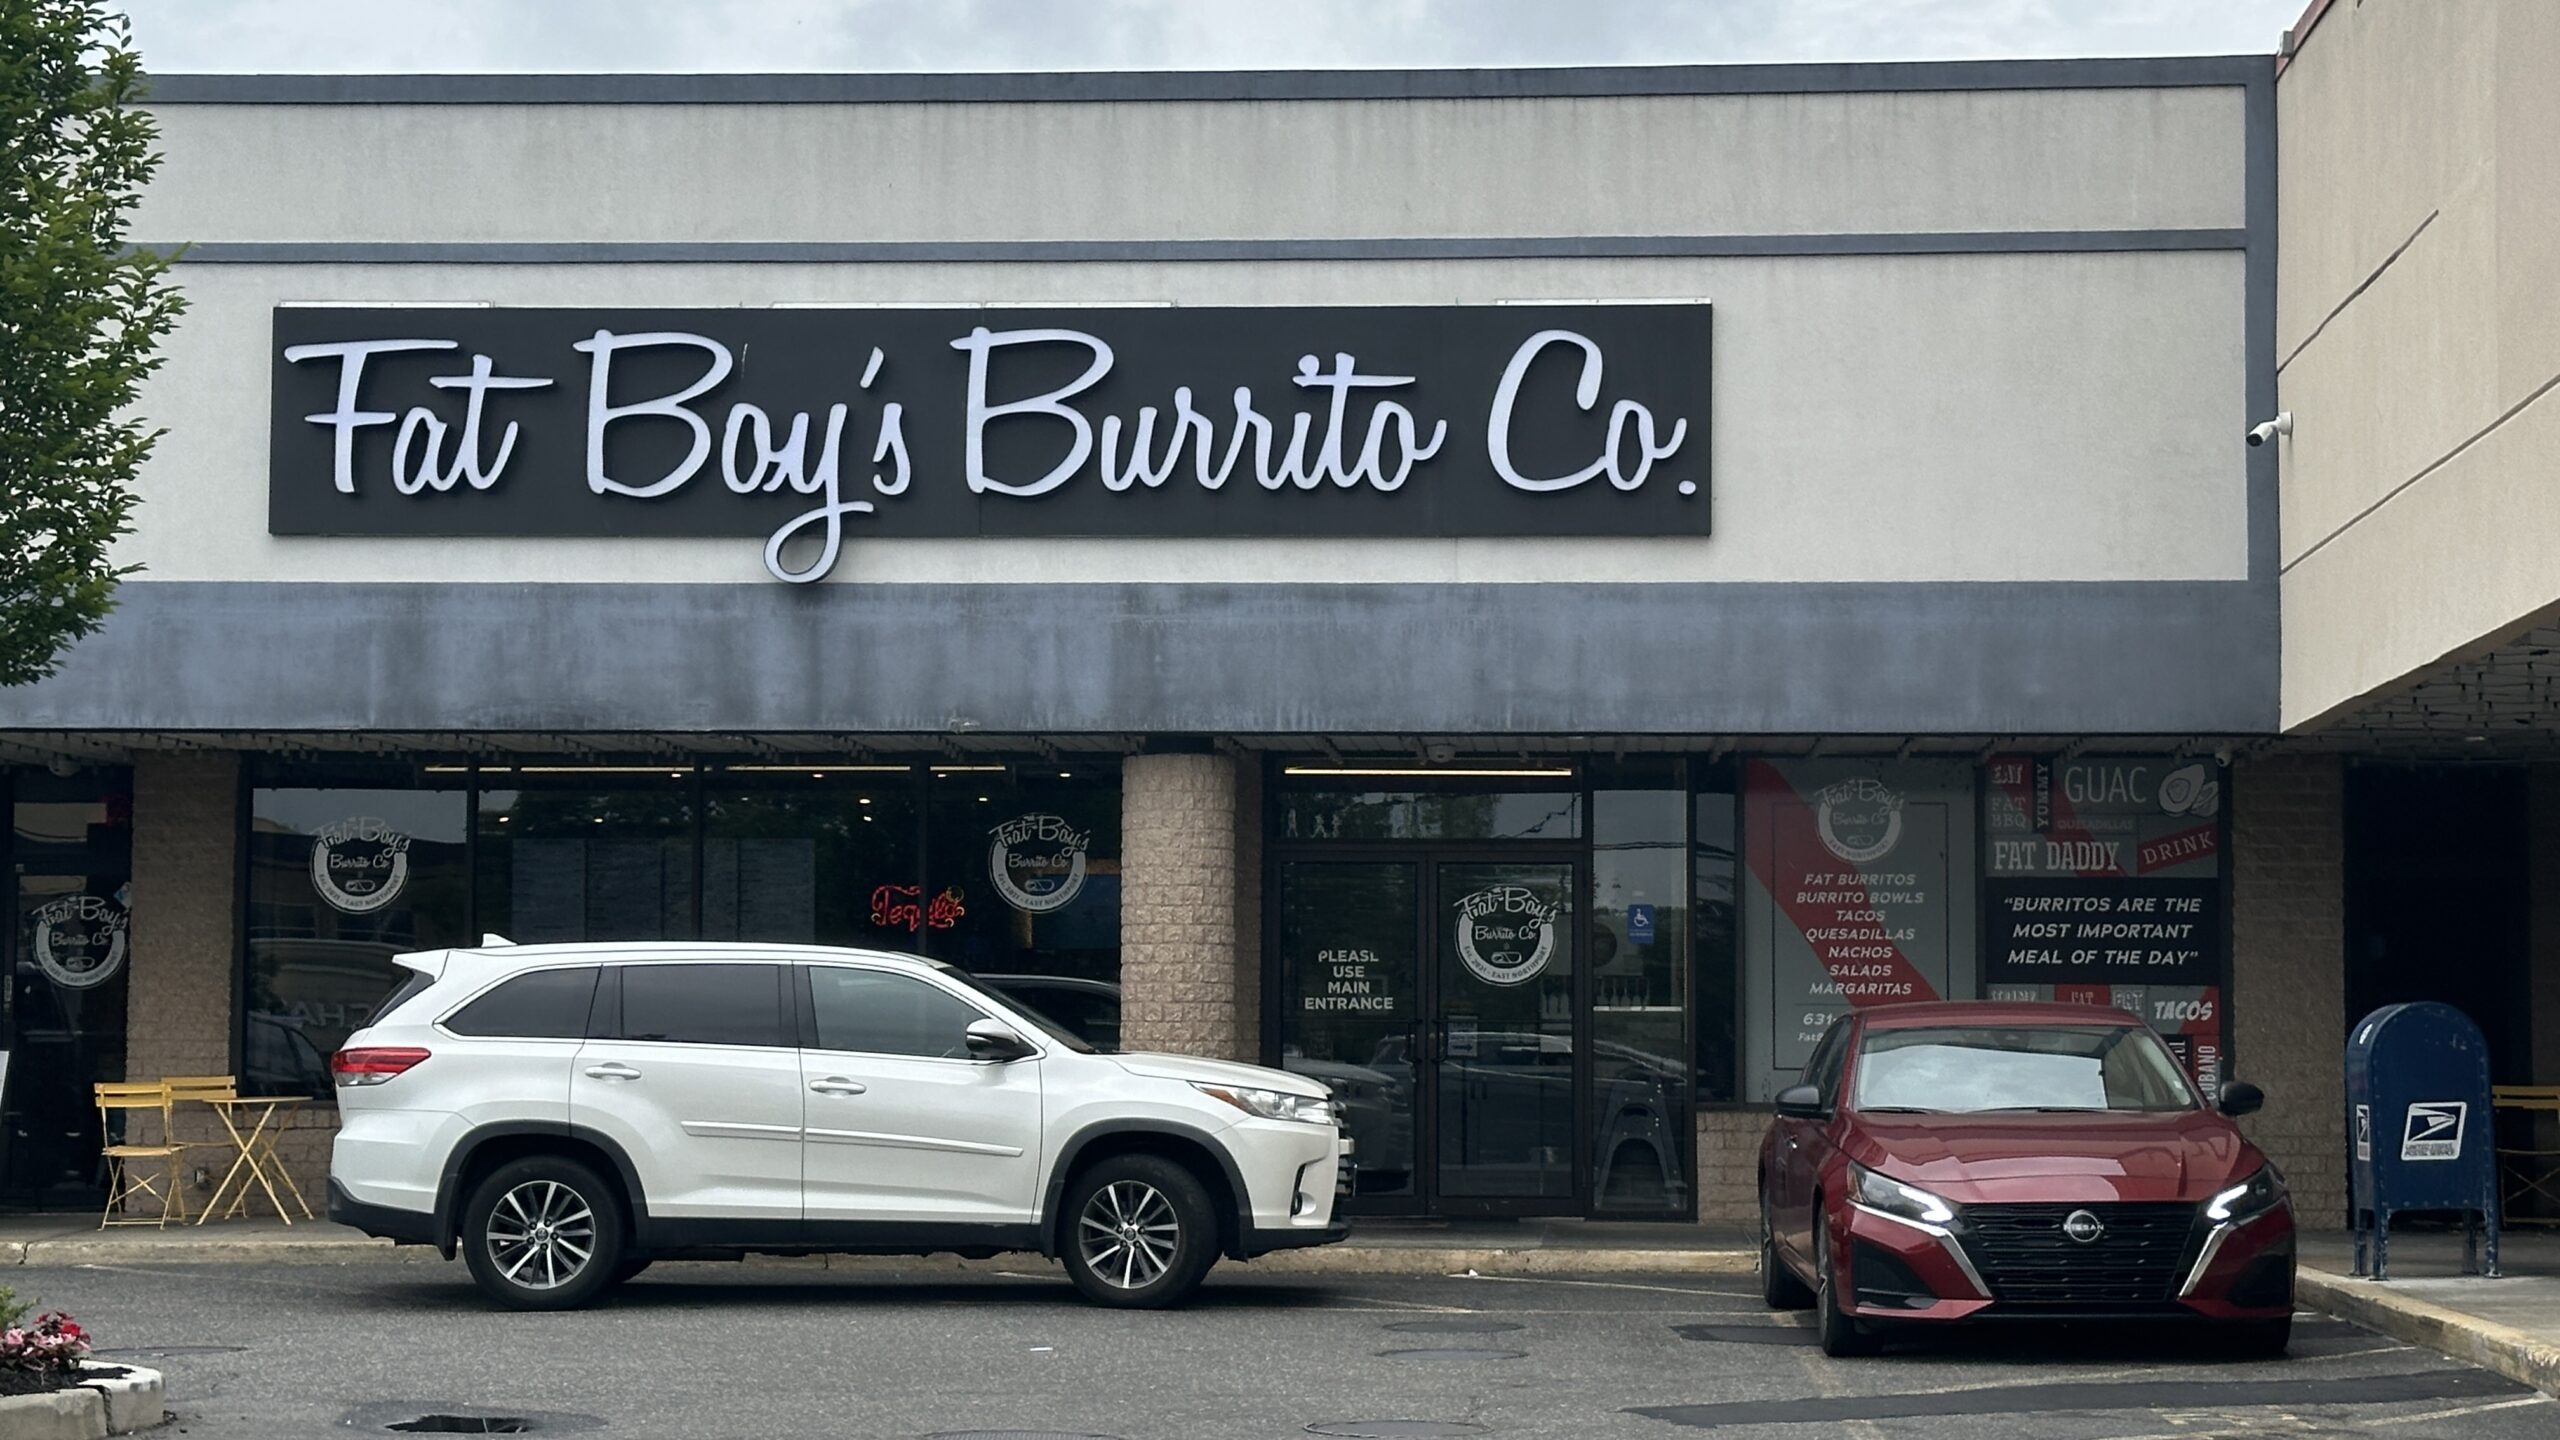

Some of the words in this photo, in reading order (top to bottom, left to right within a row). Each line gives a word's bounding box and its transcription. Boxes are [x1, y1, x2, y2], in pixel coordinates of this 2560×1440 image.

[284, 340, 554, 495] Fat
[572, 329, 911, 584] Boy's
[950, 326, 1447, 496] Burrito
[1487, 330, 1697, 496] Co.
[2064, 766, 2147, 803] GUAC
[2036, 763, 2049, 829] YUMMY
[987, 819, 1037, 848] Fat
[1037, 815, 1091, 858] Boy's
[2142, 831, 2215, 865] DRINK
[1994, 841, 2037, 871] FAT
[2046, 841, 2120, 872] DADDY
[1804, 873, 1834, 885] FAT
[1837, 873, 1917, 885] BURRITOS
[1796, 891, 1865, 904] BURRITO
[1869, 892, 1924, 904] BOWLS
[2116, 898, 2157, 912] ARE
[2164, 898, 2202, 912] THE
[30, 898, 79, 926] Fat
[1453, 890, 1504, 919] Fat
[1504, 886, 1558, 929] Boy's
[1835, 910, 1886, 922] TACOS
[1474, 925, 1516, 941] Burrito
[1806, 928, 1915, 943] QUESADILLAS
[2012, 923, 2072, 938] MOST
[2076, 923, 2193, 939] IMPORTANT
[1828, 946, 1893, 958] NACHOS
[2007, 949, 2063, 965] MEAL
[2071, 950, 2098, 965] OF
[2104, 950, 2142, 965] THE
[1333, 965, 1365, 978] USE
[1829, 964, 1893, 976] SALADS
[1327, 981, 1370, 994] MAIN
[1809, 982, 1912, 995] MARGARITAS
[1304, 997, 1394, 1010] ENTRANCE
[2154, 1000, 2214, 1022] TACOS
